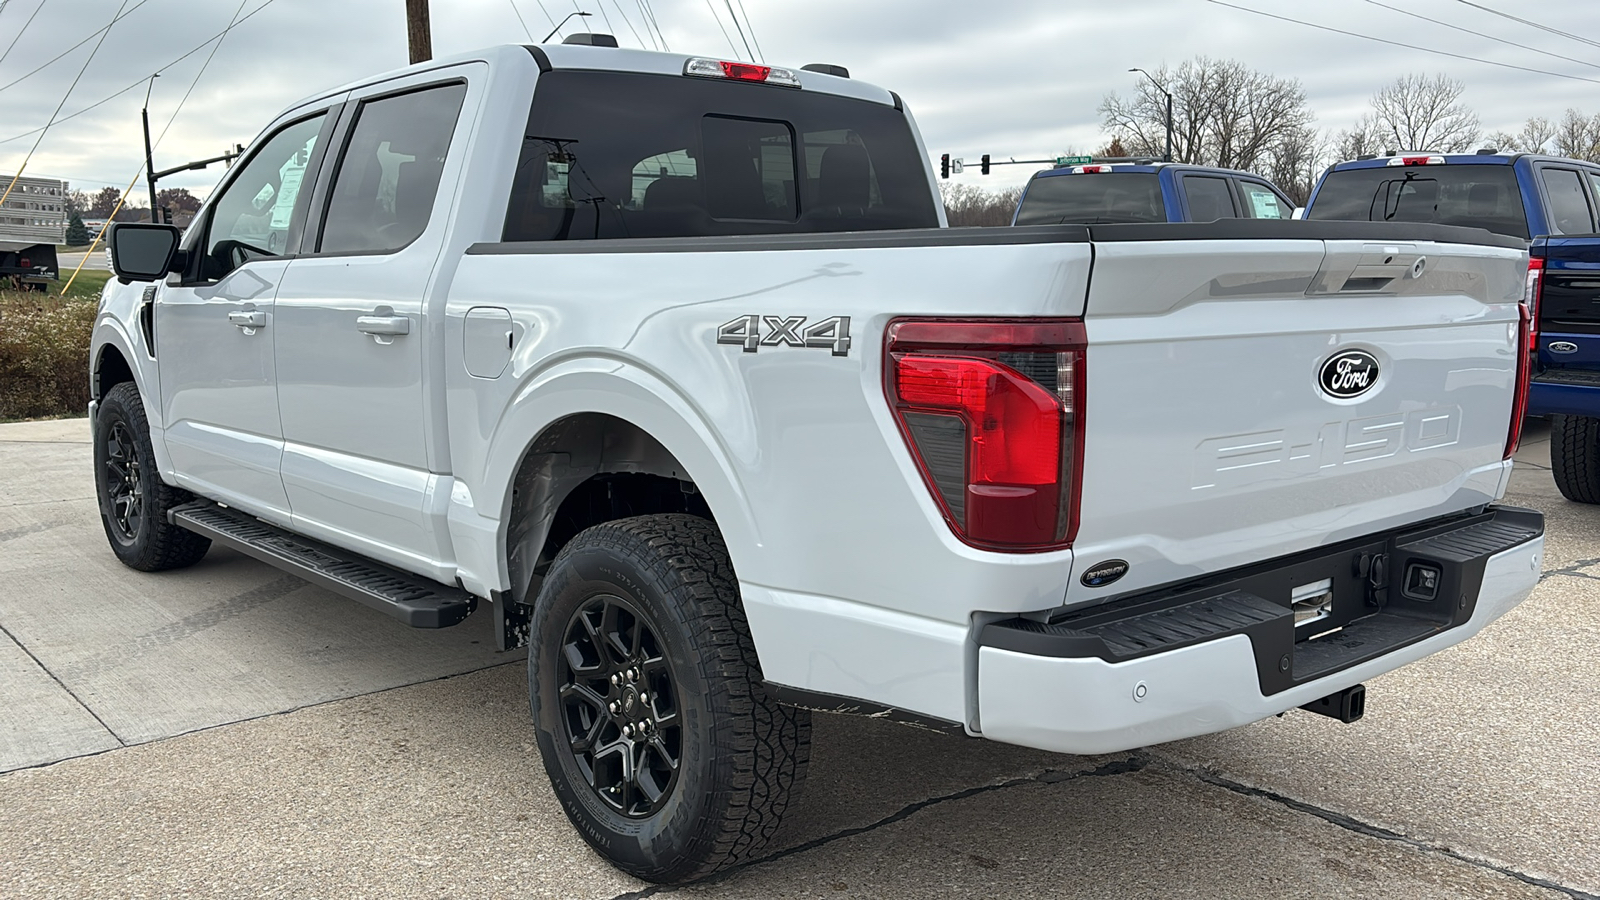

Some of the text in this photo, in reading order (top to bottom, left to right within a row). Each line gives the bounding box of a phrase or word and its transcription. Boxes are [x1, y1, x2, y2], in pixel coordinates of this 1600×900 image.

[1331, 358, 1371, 390] Ford
[1191, 404, 1462, 490] F-150
[566, 800, 612, 849] TERRITORY
